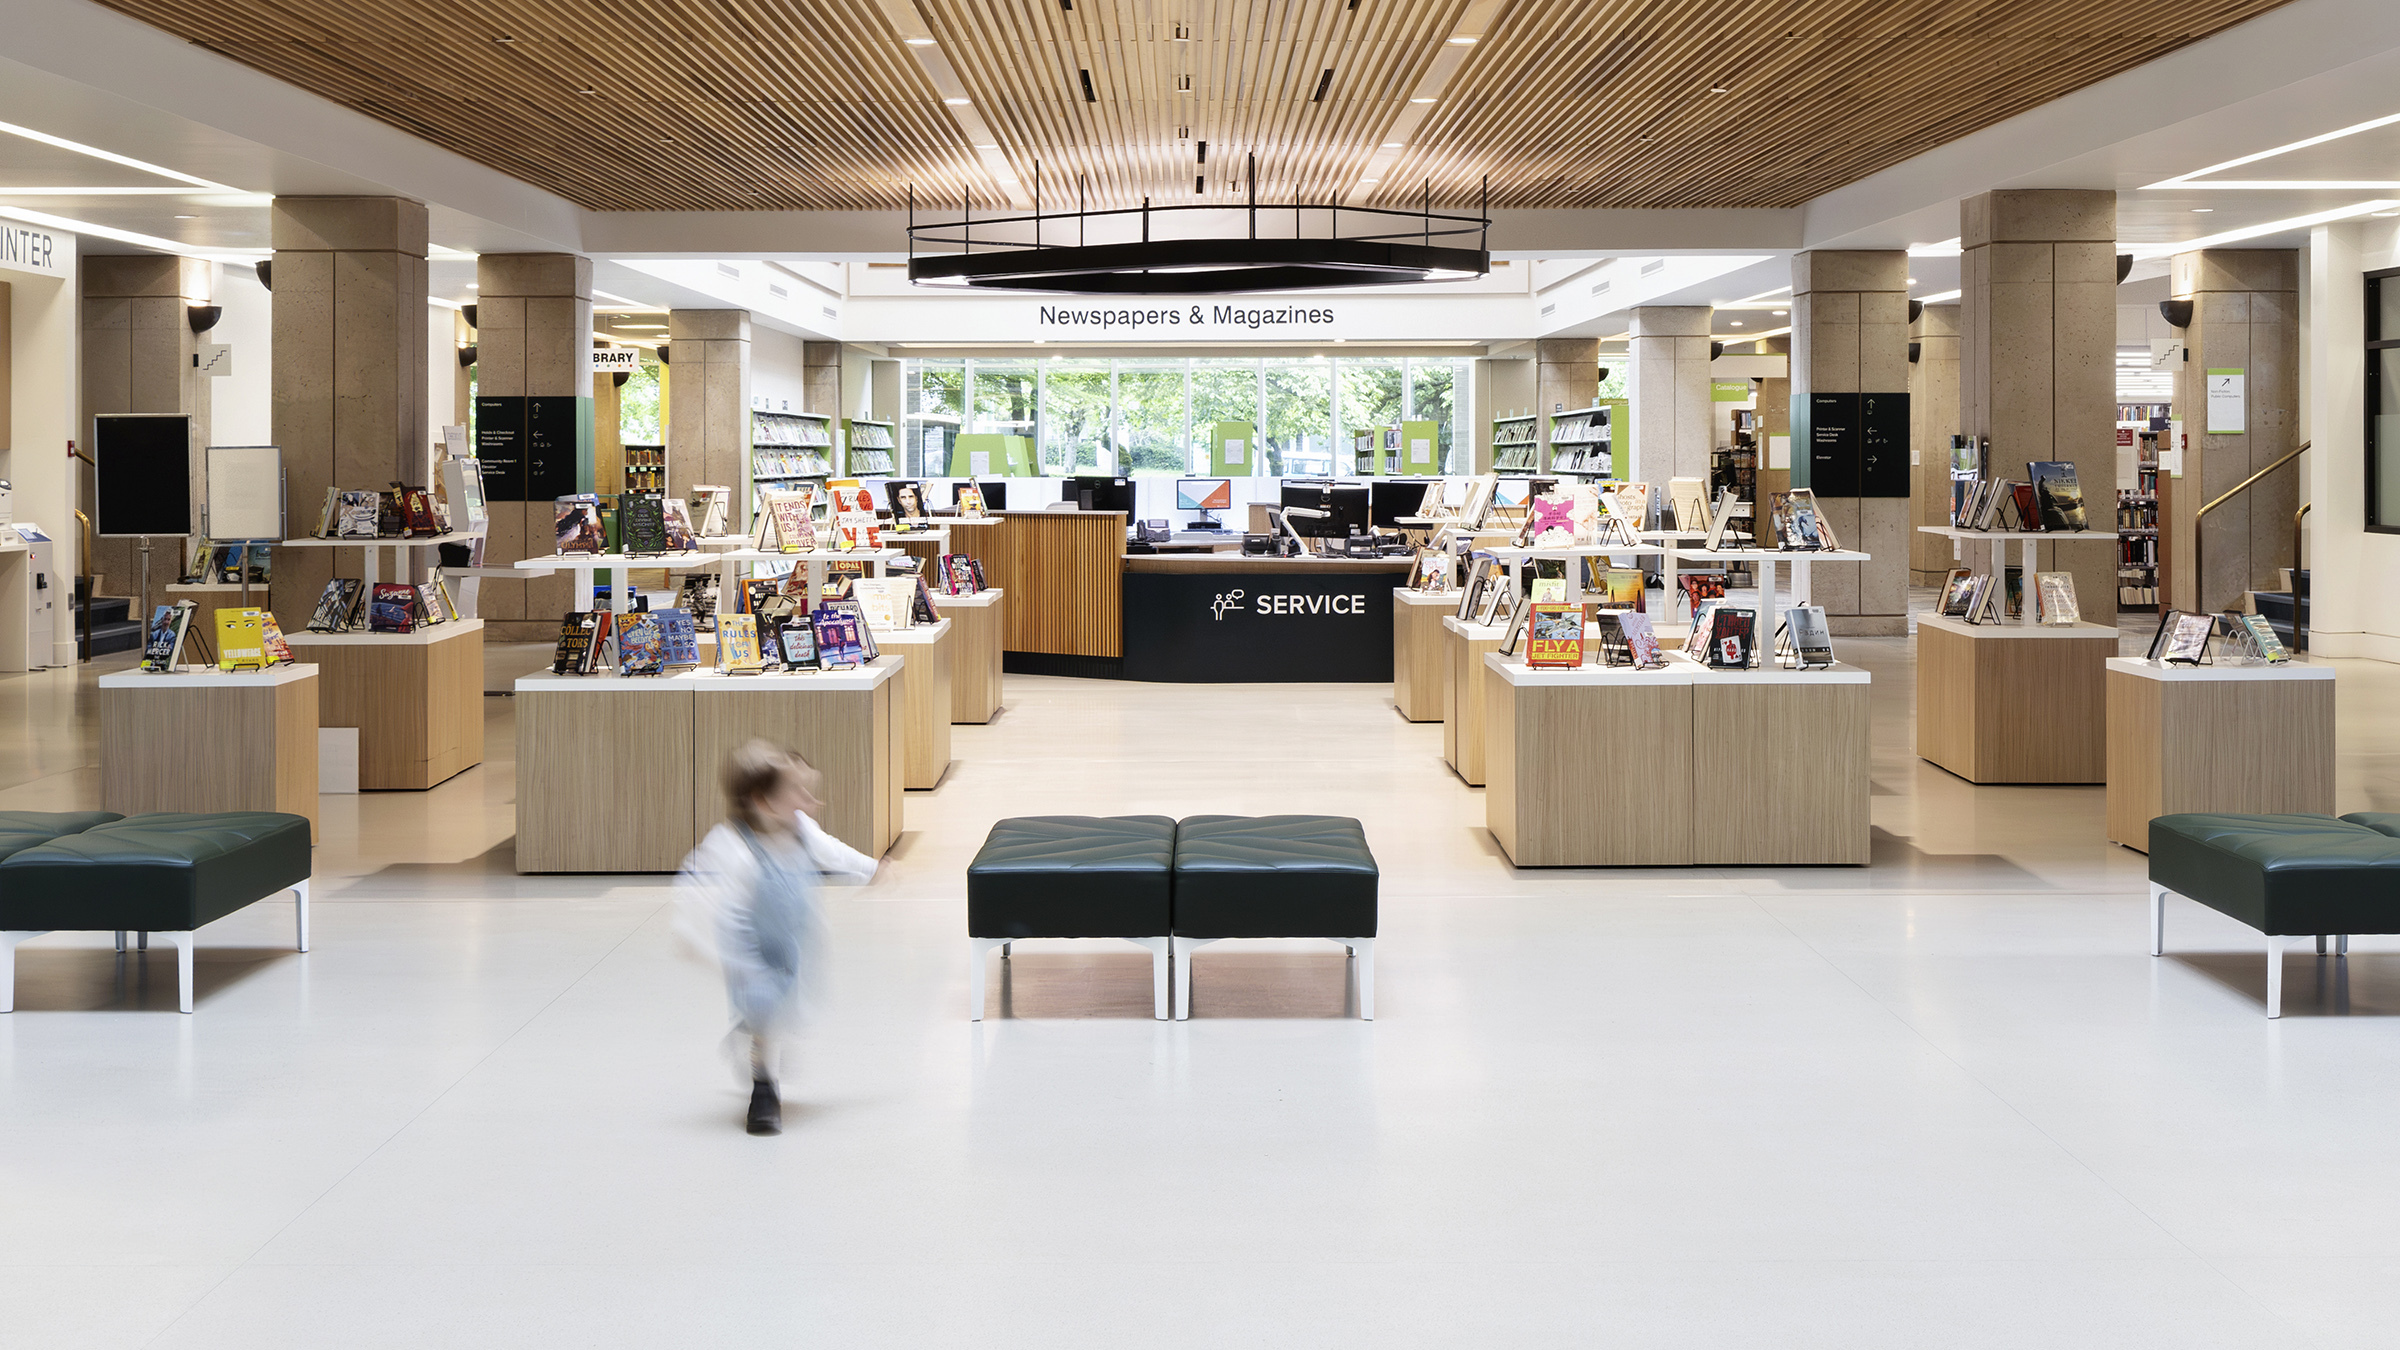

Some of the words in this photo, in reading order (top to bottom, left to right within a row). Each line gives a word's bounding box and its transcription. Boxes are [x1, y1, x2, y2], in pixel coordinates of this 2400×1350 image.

[0, 225, 53, 269] INTER
[1039, 305, 1181, 330] Newspapers
[1188, 305, 1205, 325] &
[1213, 304, 1335, 330] Magazines
[592, 352, 634, 363] BRARY
[1715, 384, 1748, 392] Catalogue
[775, 502, 783, 512] IT
[783, 500, 806, 511] ENDS
[777, 513, 800, 522] WITH
[780, 522, 793, 533] US
[839, 561, 860, 569] OPAL
[1256, 594, 1366, 615] SERVICE
[680, 626, 693, 634] NO
[722, 630, 757, 638] RULES
[668, 633, 695, 641] MAYBE
[567, 638, 589, 648] TORS
[1532, 640, 1566, 652] FLY
[1566, 640, 1580, 652] A
[146, 648, 170, 656] MERCER
[223, 647, 262, 659] YELLOWFACE
[734, 649, 750, 659] US
